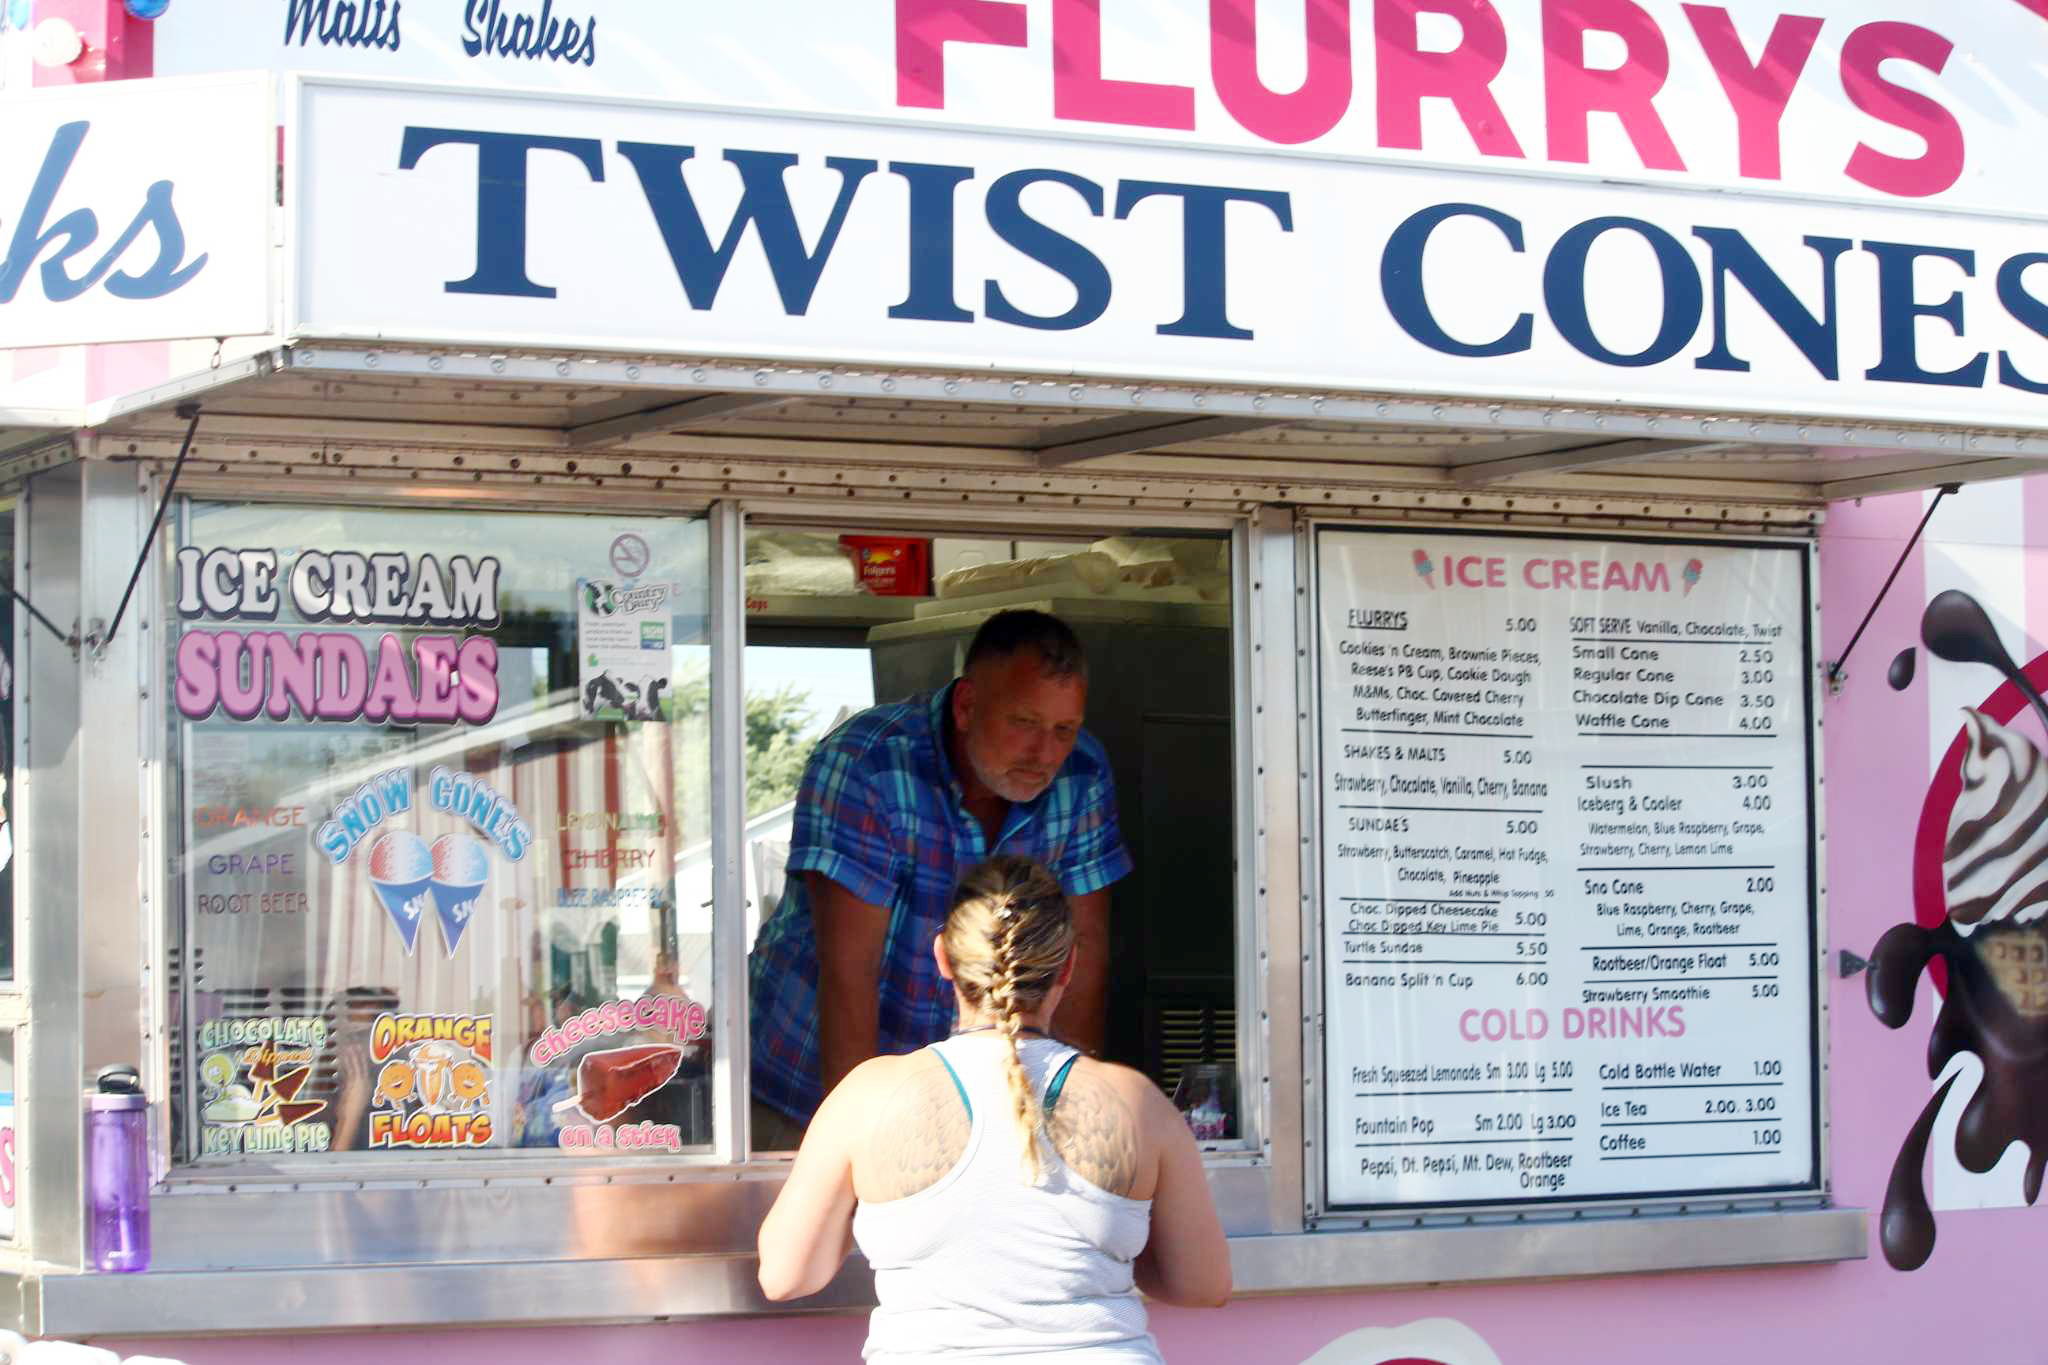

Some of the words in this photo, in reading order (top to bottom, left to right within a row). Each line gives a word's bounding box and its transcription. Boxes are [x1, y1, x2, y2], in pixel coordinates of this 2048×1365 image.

[284, 0, 400, 51] Malts
[462, 0, 597, 67] Shakes
[895, 0, 1965, 198] FLURRYS
[398, 126, 1294, 340] TWIST
[1443, 555, 1507, 588] ICE
[1522, 558, 1670, 593] CREAM
[176, 546, 279, 622] ICE
[288, 548, 501, 629] CREAM
[1349, 609, 1408, 628] FLURRYS
[1505, 618, 1537, 632] 5.00
[1570, 617, 1595, 633] SOFT
[1599, 618, 1630, 633] SERVE
[1753, 624, 1782, 637] Twist
[1339, 640, 1385, 656] Cookies
[1449, 646, 1497, 661] Brownie
[1572, 646, 1614, 660] Small
[1621, 647, 1658, 661] Cone
[1739, 650, 1773, 663] 2.50
[175, 629, 500, 726] SUNDAES
[1351, 662, 1393, 678] Reese's
[1398, 664, 1412, 678] PB
[1447, 666, 1488, 682] Cookie
[1492, 669, 1532, 686] Dough
[1573, 667, 1630, 683] Regular
[1637, 669, 1674, 682] Cone
[1741, 670, 1773, 684] 3.00
[1432, 688, 1481, 703] Covered
[1485, 690, 1524, 708] Cherry
[1572, 690, 1648, 704] Chocolate
[1654, 692, 1680, 708] Dip
[1685, 693, 1723, 706] Cone
[1739, 695, 1774, 708] 3.50
[1433, 710, 1460, 724] Mint
[1464, 711, 1524, 727] Chocolate
[1575, 713, 1625, 729] Waffle
[1631, 715, 1669, 729] Cone
[1739, 716, 1771, 729] 4.00
[1344, 744, 1391, 760] SHAKES
[1395, 746, 1404, 760] &
[1407, 747, 1445, 761] MALTS
[1503, 750, 1532, 764] 5.00
[1512, 779, 1547, 797] Banana
[1586, 776, 1632, 789] Slush
[1733, 775, 1767, 789] 3.00
[315, 766, 411, 864] SNOW
[429, 764, 533, 862] CONES
[1577, 797, 1623, 816] Iceberg
[1628, 796, 1637, 810] &
[1642, 796, 1682, 811] Cooler
[1743, 796, 1771, 810] 4.00
[1506, 820, 1537, 834] 5.00
[1654, 822, 1675, 834] Blue
[565, 848, 656, 869] CHERRY
[1499, 848, 1515, 860] Hot
[1675, 843, 1706, 855] Lemon
[1711, 842, 1733, 854] Lime
[208, 854, 294, 876] GRAPE
[1453, 871, 1500, 886] Pineapple
[1585, 879, 1607, 894] Sno
[1612, 879, 1643, 894] Cone
[1747, 877, 1774, 892] 2.00
[199, 894, 252, 914] ROOT
[260, 893, 310, 913] BEER
[1386, 903, 1426, 919] Dipped
[1431, 903, 1498, 917] Cheesecake
[1597, 904, 1619, 915] Blue
[1427, 920, 1446, 933] Key
[1451, 920, 1476, 932] Lime
[1482, 920, 1498, 932] Pie
[1515, 912, 1546, 926] 5.00
[1693, 922, 1740, 934] Rootbeer
[1344, 941, 1375, 953] Turtle
[1380, 942, 1422, 953] Sundae
[1515, 942, 1547, 956] 5.50
[1593, 955, 1694, 973] Rootbeer/Orange
[1698, 953, 1727, 968] Float
[1749, 953, 1779, 966] 5.00
[1345, 972, 1395, 986] Banana
[1401, 973, 1429, 989] Split
[1450, 973, 1472, 989] Cup
[1516, 972, 1548, 985] 6.00
[1582, 989, 1648, 1004] Strawberry
[1652, 987, 1710, 1000] Smoothie
[1752, 984, 1779, 998] 5.00
[201, 1017, 328, 1049] CHOCOLATE
[1459, 1008, 1549, 1042] COLD
[1562, 1005, 1685, 1039] DRINKS
[370, 1012, 494, 1064] ORANGE
[1352, 1066, 1378, 1083] Fresh
[1382, 1065, 1427, 1087] Squeezed
[1431, 1064, 1480, 1082] Lemonade
[1486, 1063, 1500, 1080] Sm
[1507, 1061, 1527, 1078] 3.00
[1535, 1061, 1545, 1083] Lg
[1552, 1061, 1572, 1078] 5.00
[1599, 1064, 1629, 1080] Cold
[1636, 1063, 1675, 1078] Bottle
[1680, 1062, 1721, 1077] Water
[1754, 1061, 1781, 1075] 1.00
[1601, 1103, 1619, 1117] Ice
[1625, 1101, 1647, 1116] Tea
[1746, 1098, 1775, 1111] 3.00
[369, 1111, 495, 1149] FLOATS
[1356, 1116, 1407, 1134] Fountain
[1411, 1116, 1434, 1135] Pop
[1475, 1114, 1492, 1131] Sm
[1496, 1113, 1522, 1130] 2.00
[1531, 1113, 1543, 1135] Lg
[1547, 1115, 1576, 1129] 3.00
[1600, 1134, 1646, 1150] Coffee
[1753, 1130, 1781, 1144] 1.00
[1519, 1152, 1572, 1170] Rootbeer
[1520, 1172, 1565, 1191] Orange
